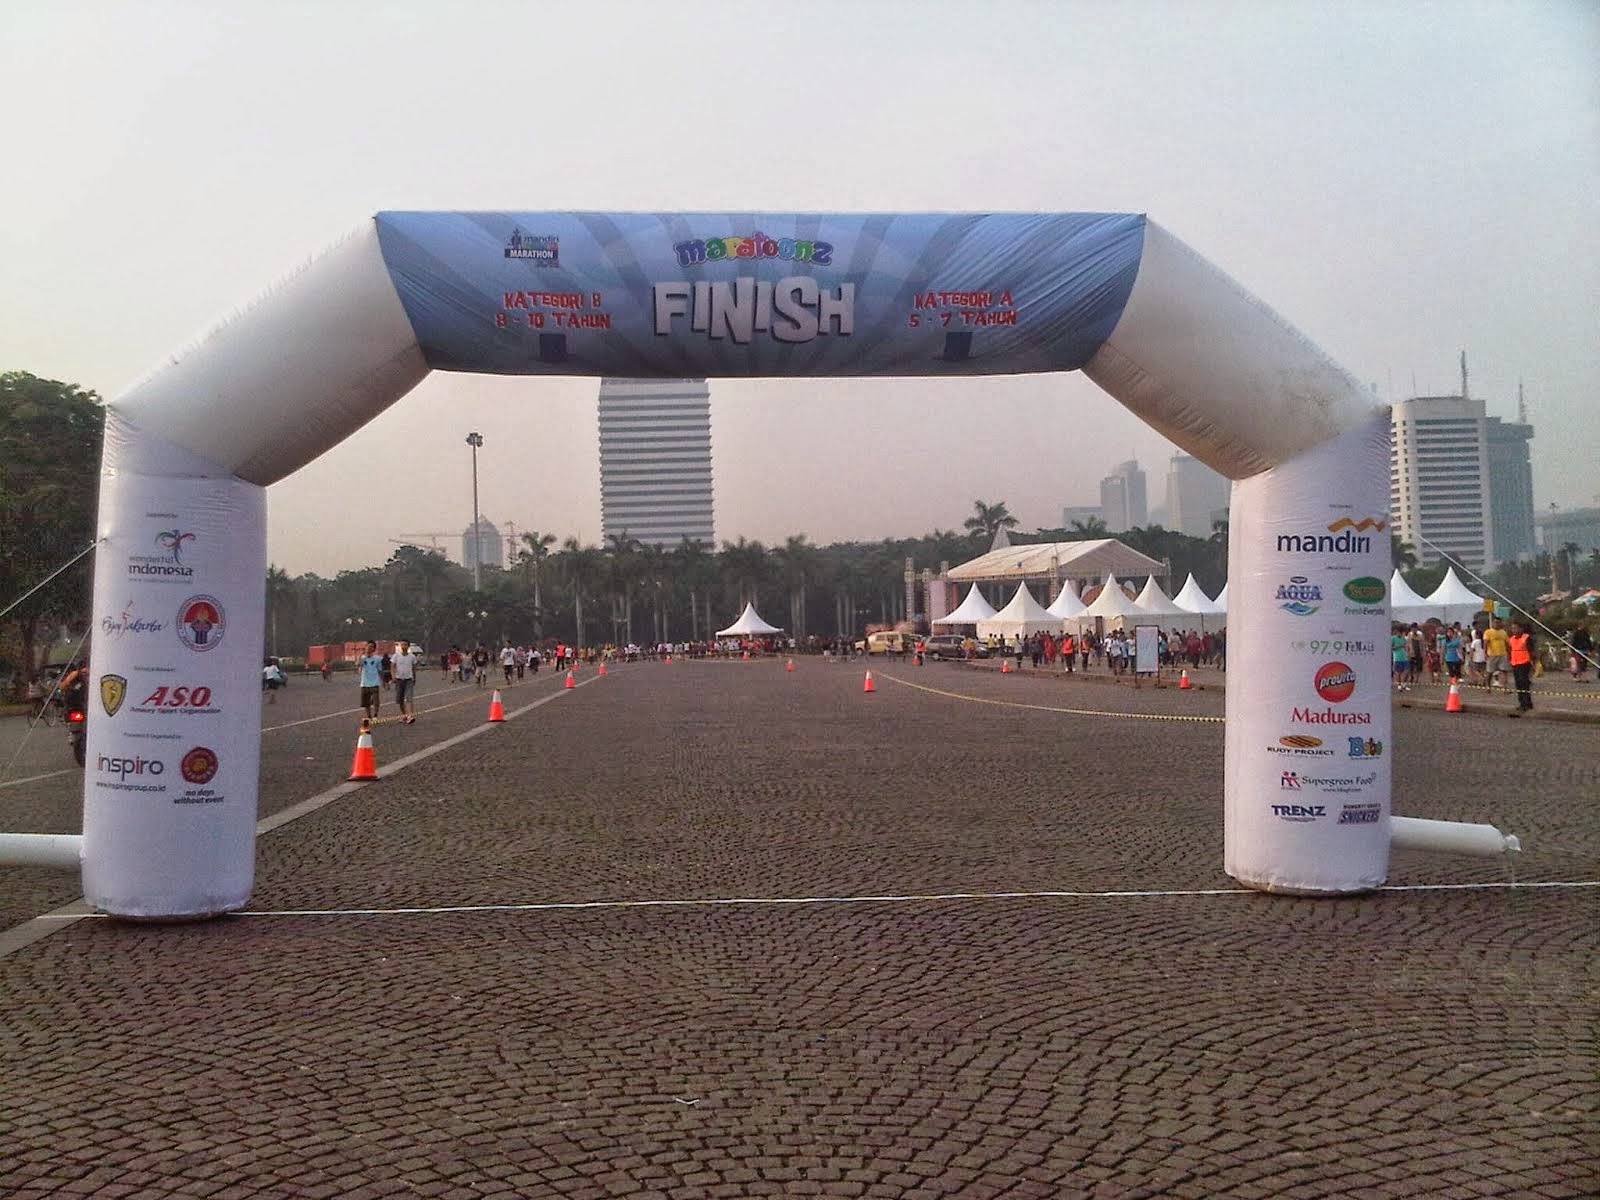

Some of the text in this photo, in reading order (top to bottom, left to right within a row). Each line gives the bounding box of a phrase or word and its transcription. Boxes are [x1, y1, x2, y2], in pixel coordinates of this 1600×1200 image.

[509, 249, 554, 259] MARATHON
[673, 232, 833, 267] maratoonz
[504, 291, 583, 310] KATEGORI
[914, 291, 1013, 310] KATEGORI A
[653, 276, 855, 344] FINISH
[528, 312, 544, 329] 10
[552, 312, 612, 329] TAHUN
[908, 314, 919, 328] 5
[942, 314, 951, 327] 7
[961, 310, 1017, 327] TAHUN
[1277, 530, 1370, 553] mandiri
[128, 563, 194, 576] indonesia
[1275, 584, 1323, 602] AQUA
[1310, 640, 1344, 655] 97.9
[1291, 707, 1371, 724] Madurasa
[1294, 748, 1334, 756] PROJECT
[97, 753, 164, 782] inspiro
[1302, 776, 1353, 787] Supergreen
[1271, 805, 1326, 817] TRENZ
